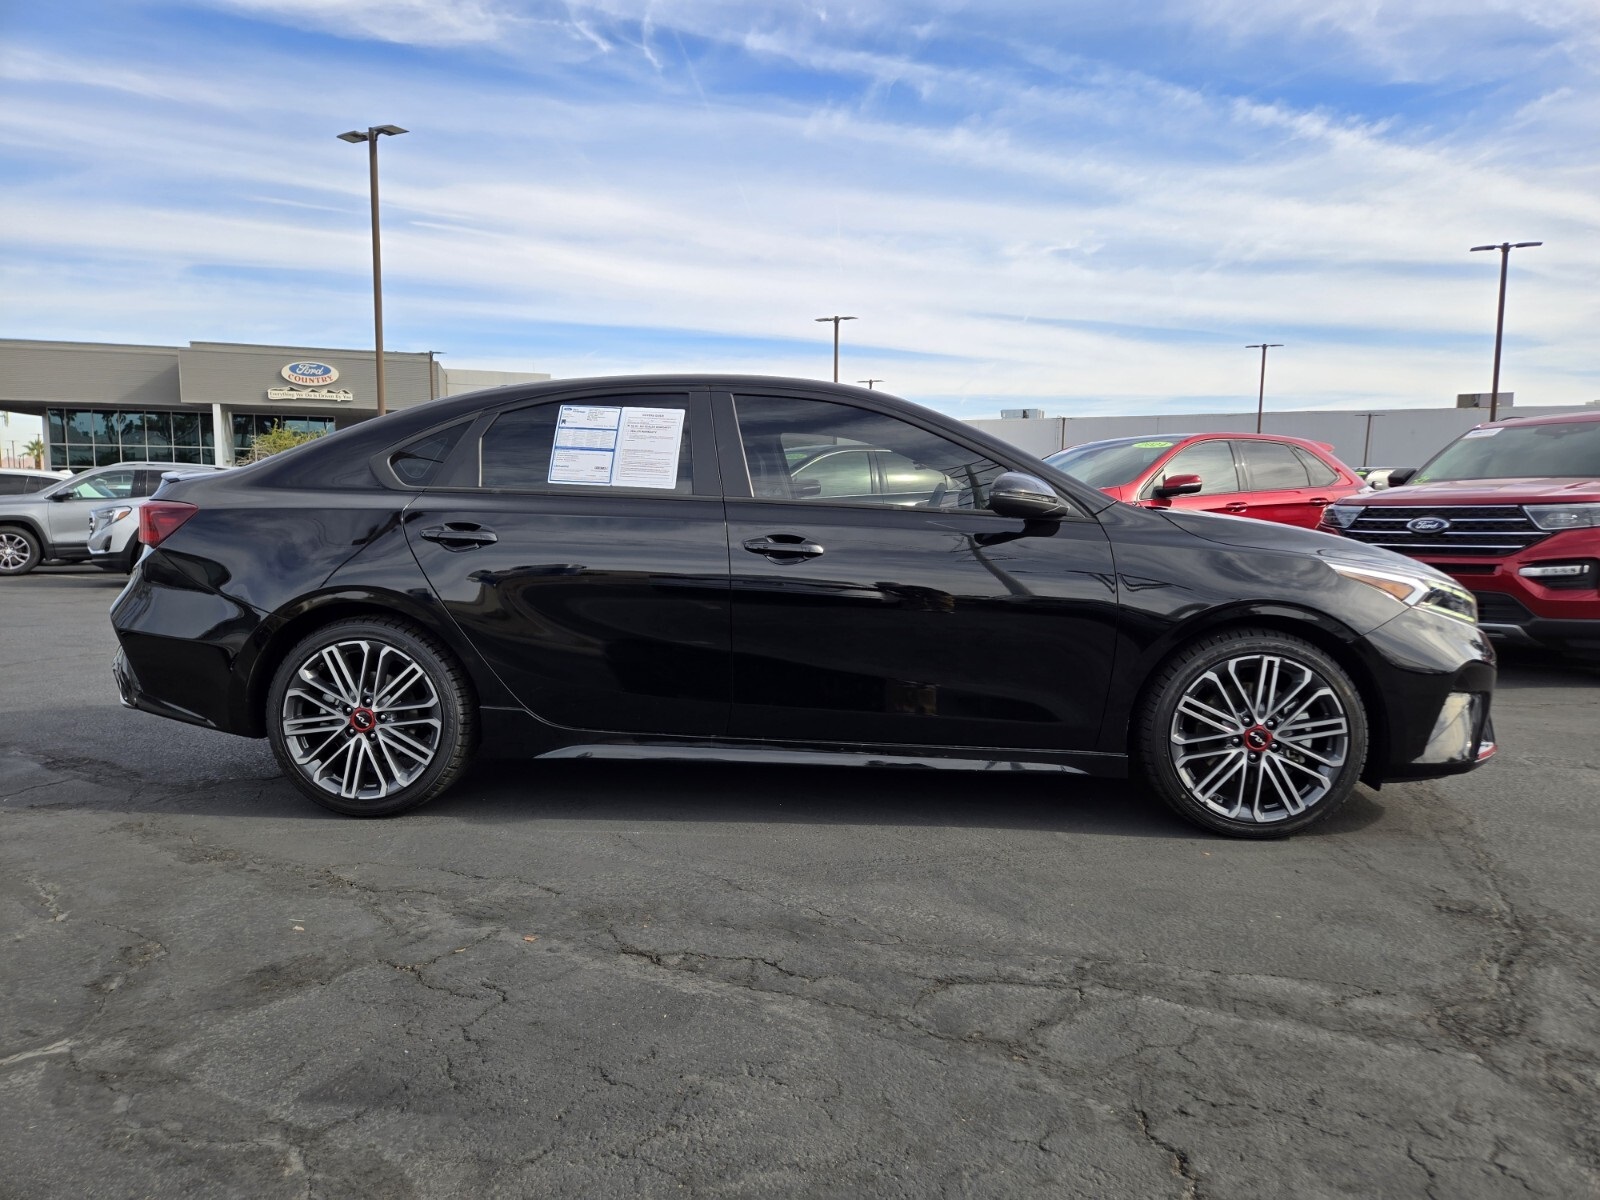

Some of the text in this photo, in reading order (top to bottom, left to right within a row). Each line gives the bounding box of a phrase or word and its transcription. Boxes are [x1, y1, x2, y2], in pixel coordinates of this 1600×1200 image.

[296, 363, 323, 375] Ford
[288, 374, 333, 384] COUNTRY
[1415, 520, 1439, 529] Ford
